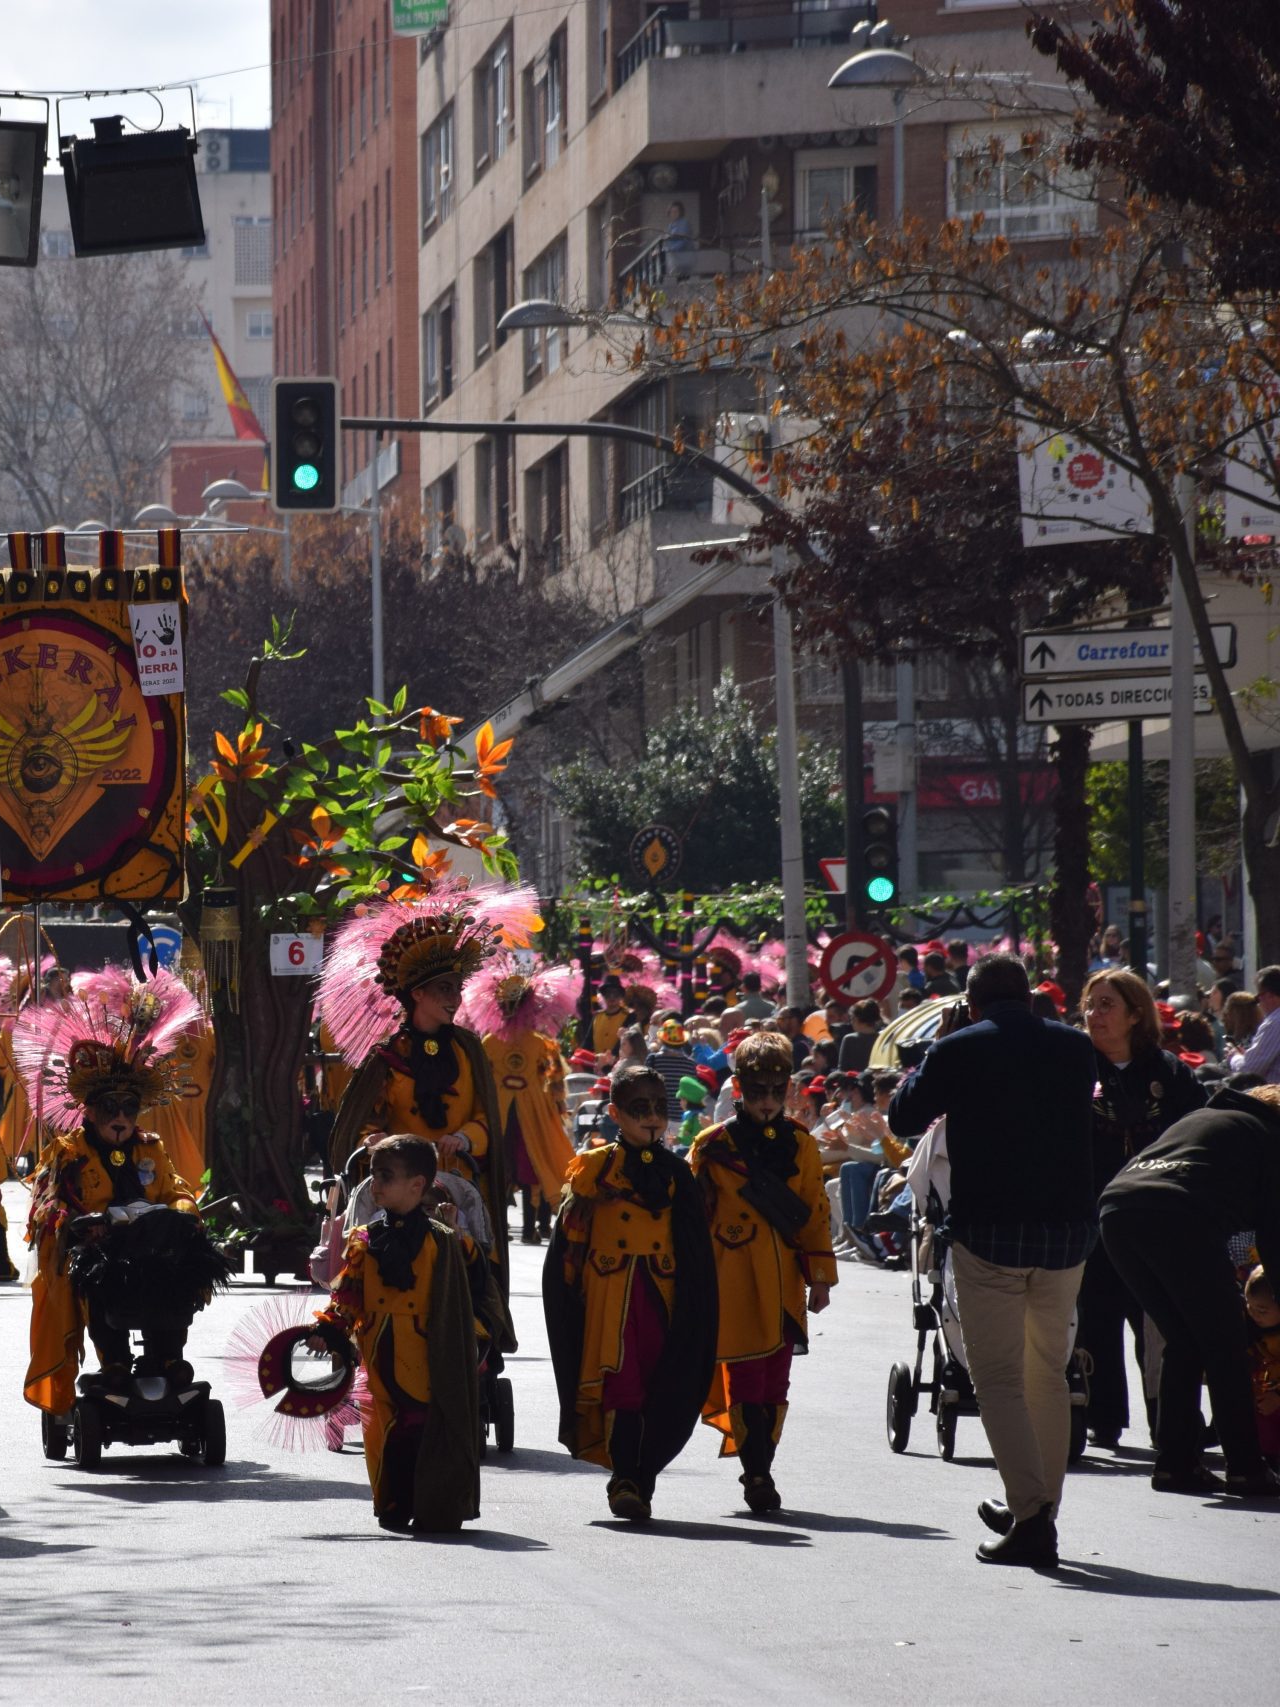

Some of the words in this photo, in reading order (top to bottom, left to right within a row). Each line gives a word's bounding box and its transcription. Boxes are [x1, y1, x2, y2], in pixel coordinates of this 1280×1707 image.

[169, 648, 178, 656] la
[1077, 641, 1169, 661] Carrefour
[140, 662, 178, 674] UERRA
[1056, 692, 1104, 708] TODAS
[1111, 685, 1208, 705] DIRECCIES
[102, 769, 141, 781] 2022
[960, 781, 1001, 800] GA
[288, 940, 305, 966] 6
